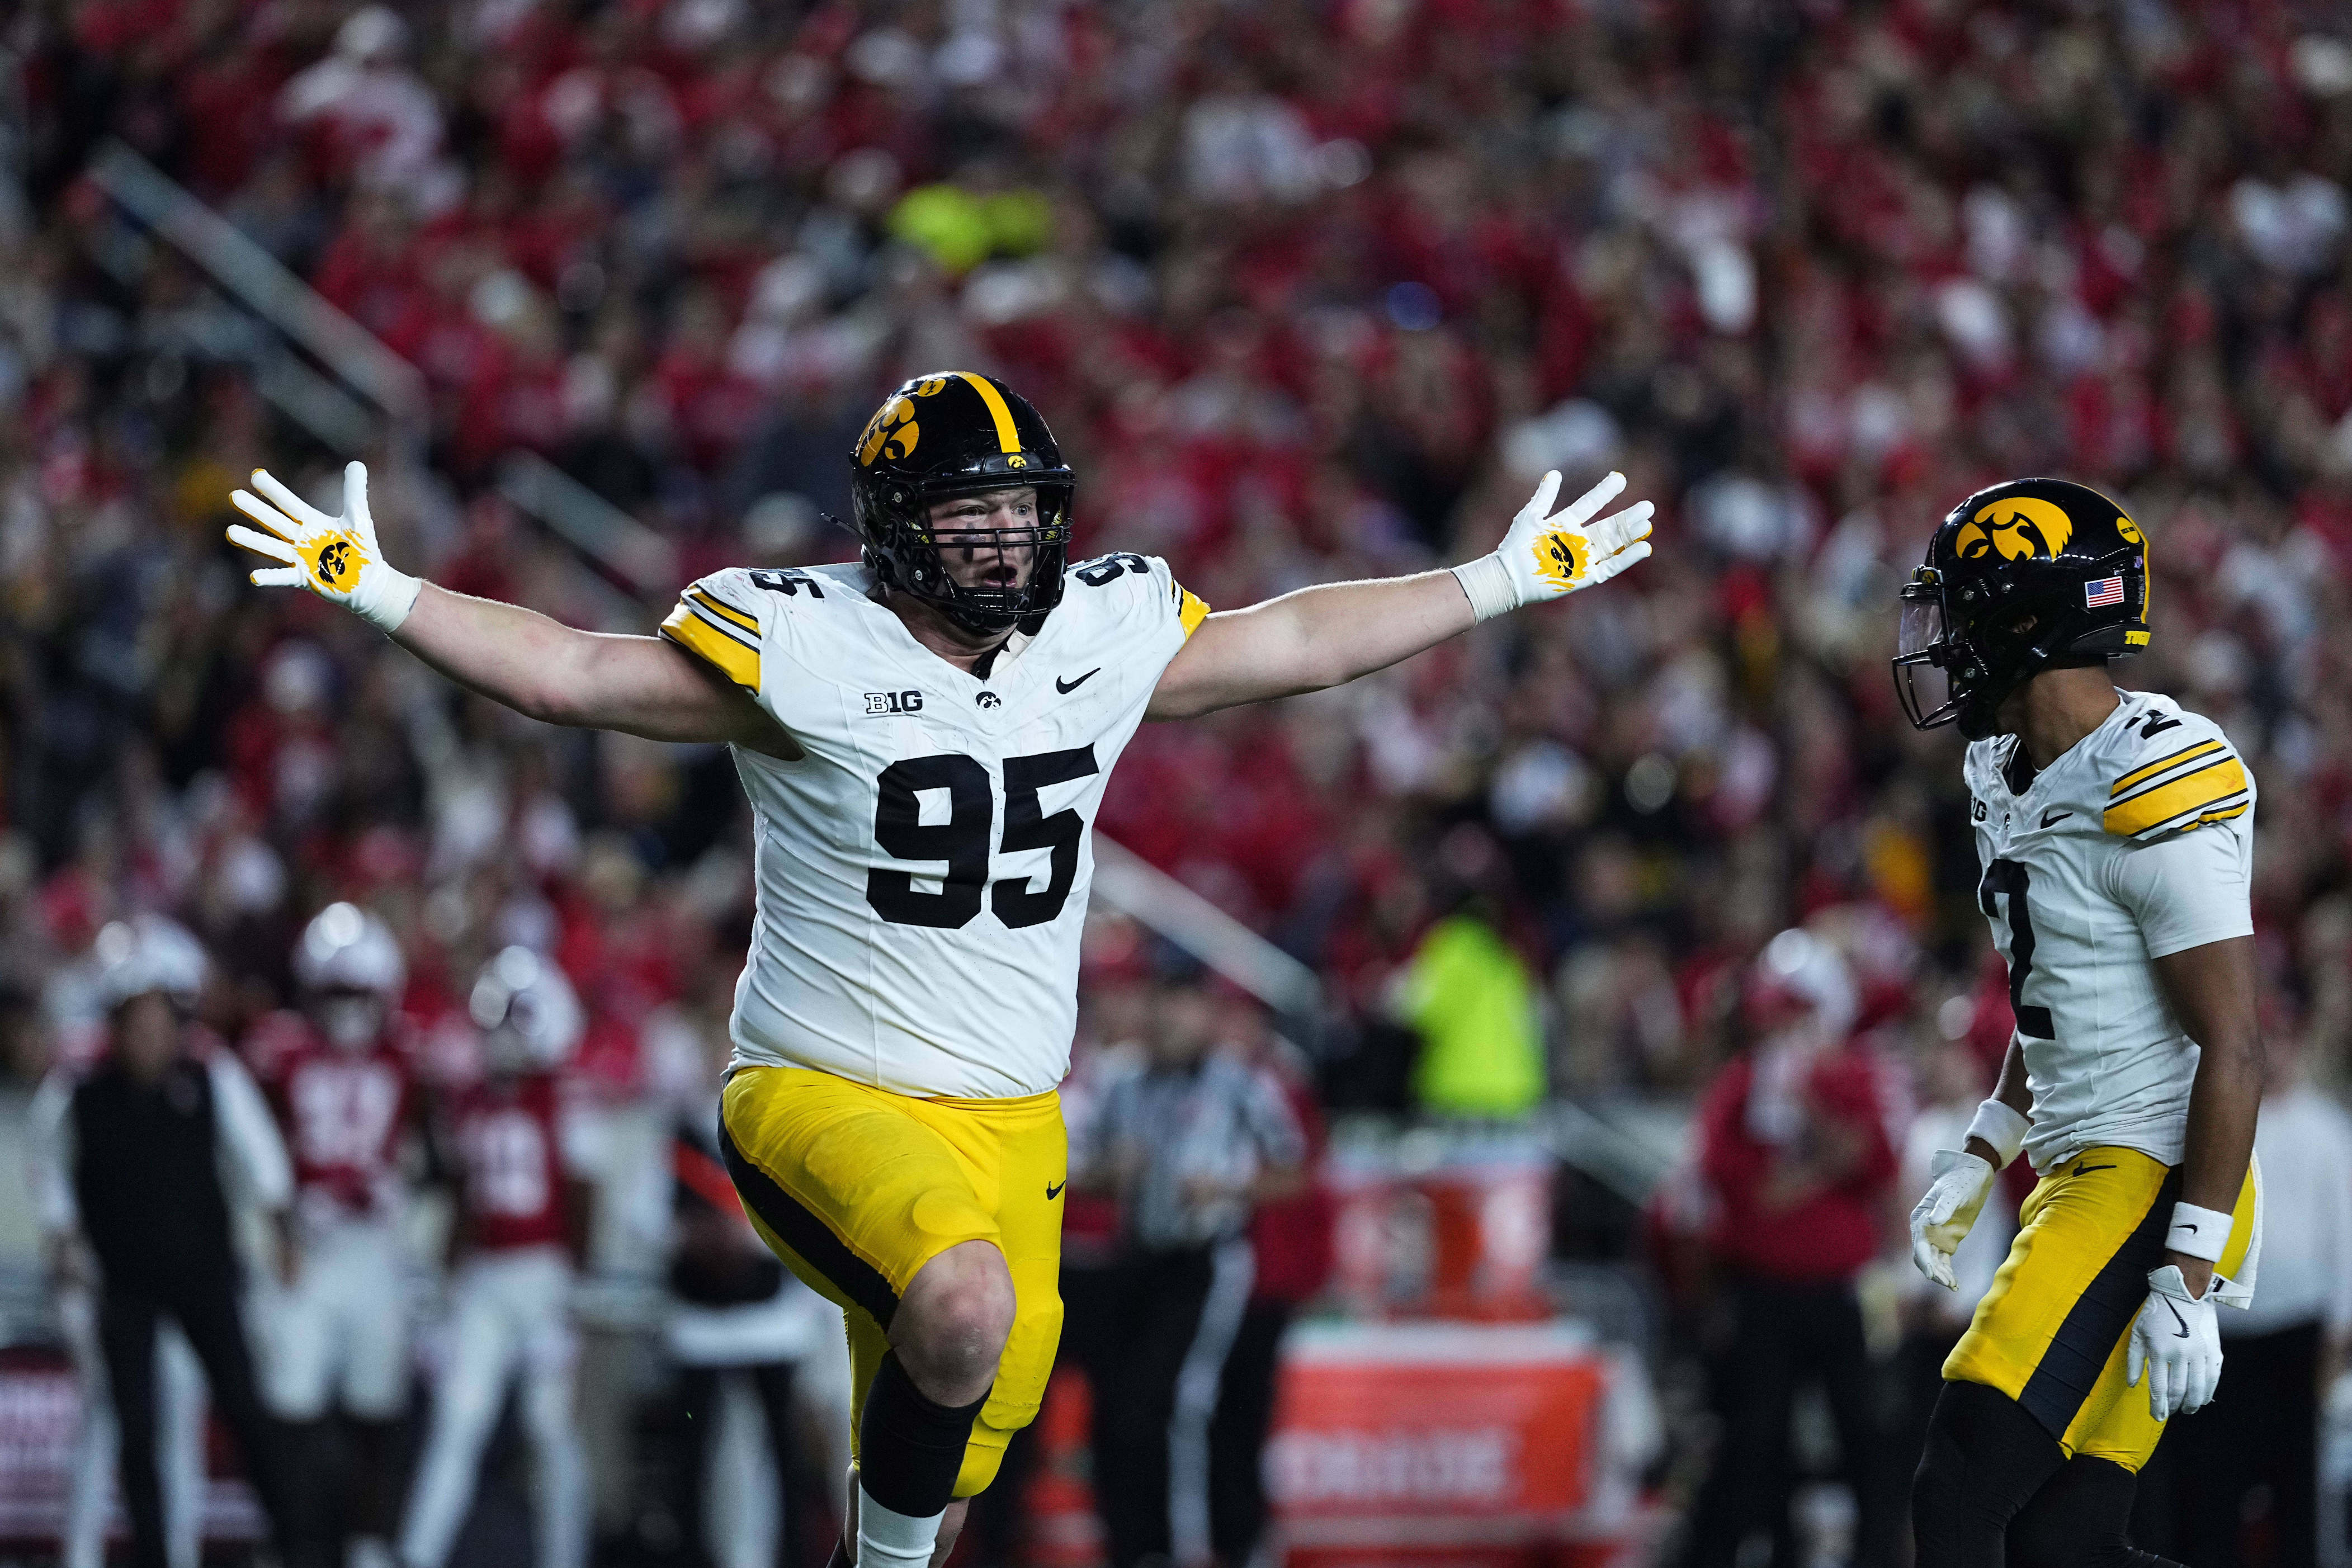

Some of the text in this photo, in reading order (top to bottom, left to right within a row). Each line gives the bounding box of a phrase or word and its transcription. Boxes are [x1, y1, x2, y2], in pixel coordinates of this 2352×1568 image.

[2124, 709, 2183, 740] 2
[867, 742, 1099, 929] 95
[1980, 859, 2055, 1040] 2
